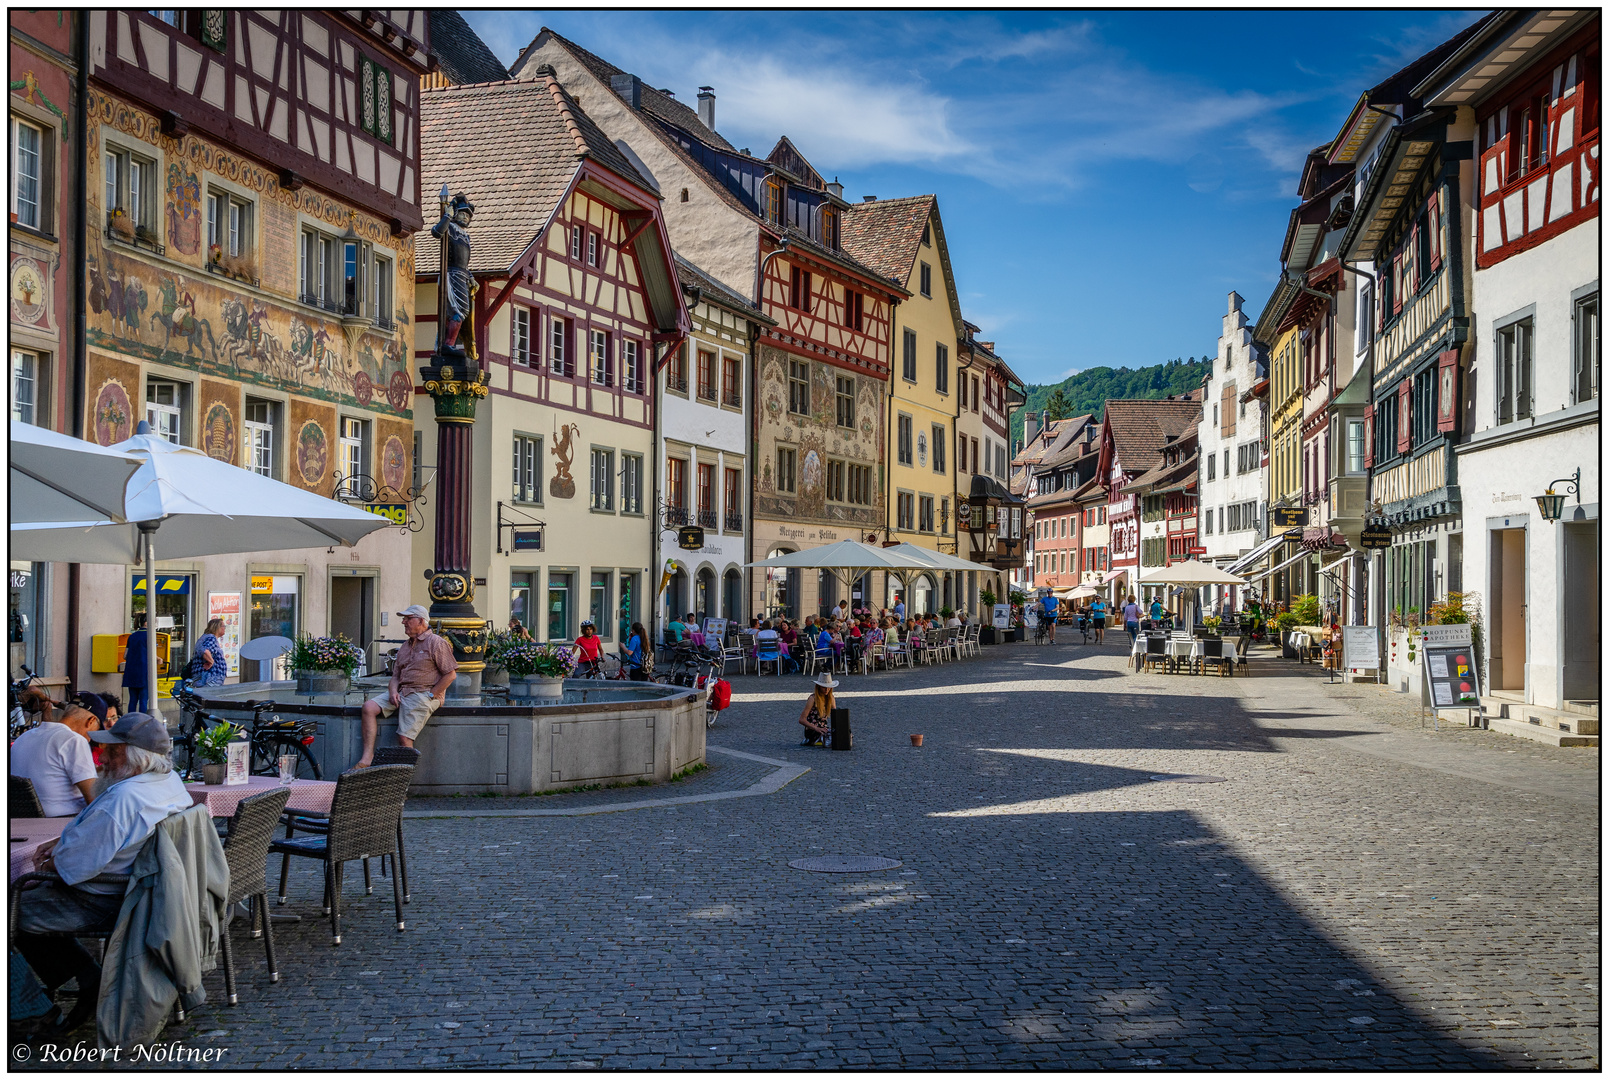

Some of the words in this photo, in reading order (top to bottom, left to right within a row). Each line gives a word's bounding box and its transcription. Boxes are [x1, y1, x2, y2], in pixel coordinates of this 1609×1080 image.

[779, 525, 805, 540] Metzgerei
[819, 529, 837, 541] Pelikan
[11, 571, 26, 588] ike
[1429, 628, 1469, 636] ROTPUNKT
